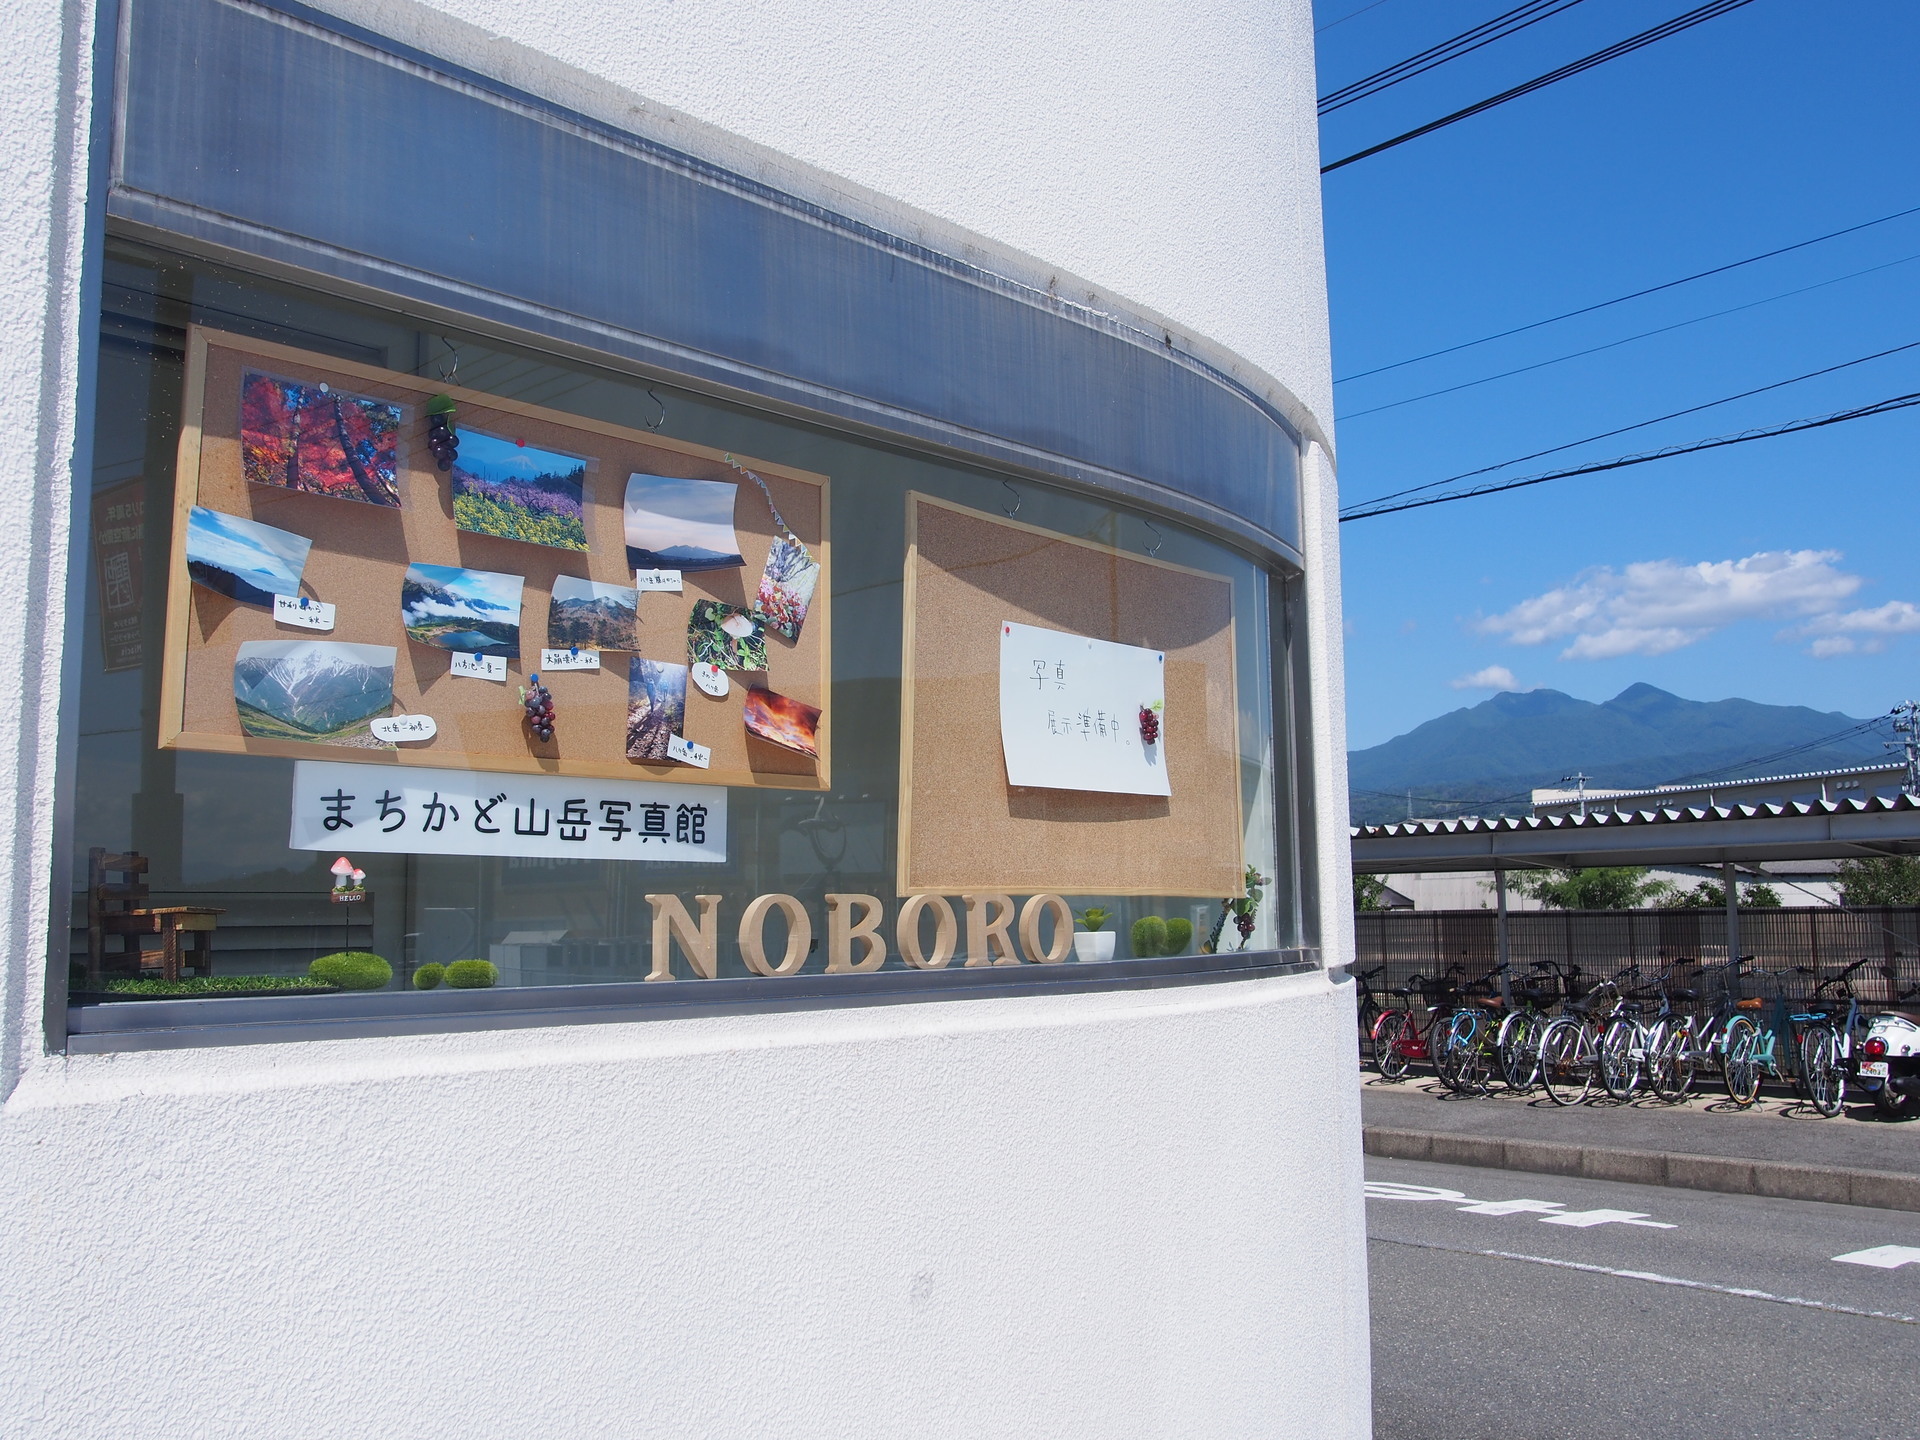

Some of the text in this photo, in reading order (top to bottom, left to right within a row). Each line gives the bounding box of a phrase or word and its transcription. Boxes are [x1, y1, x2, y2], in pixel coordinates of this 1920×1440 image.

[1029, 659, 1067, 690] 写真
[320, 788, 709, 845] まちかど山岳写真館
[339, 894, 362, 902] HELLO
[644, 893, 1075, 982] NOBORO
